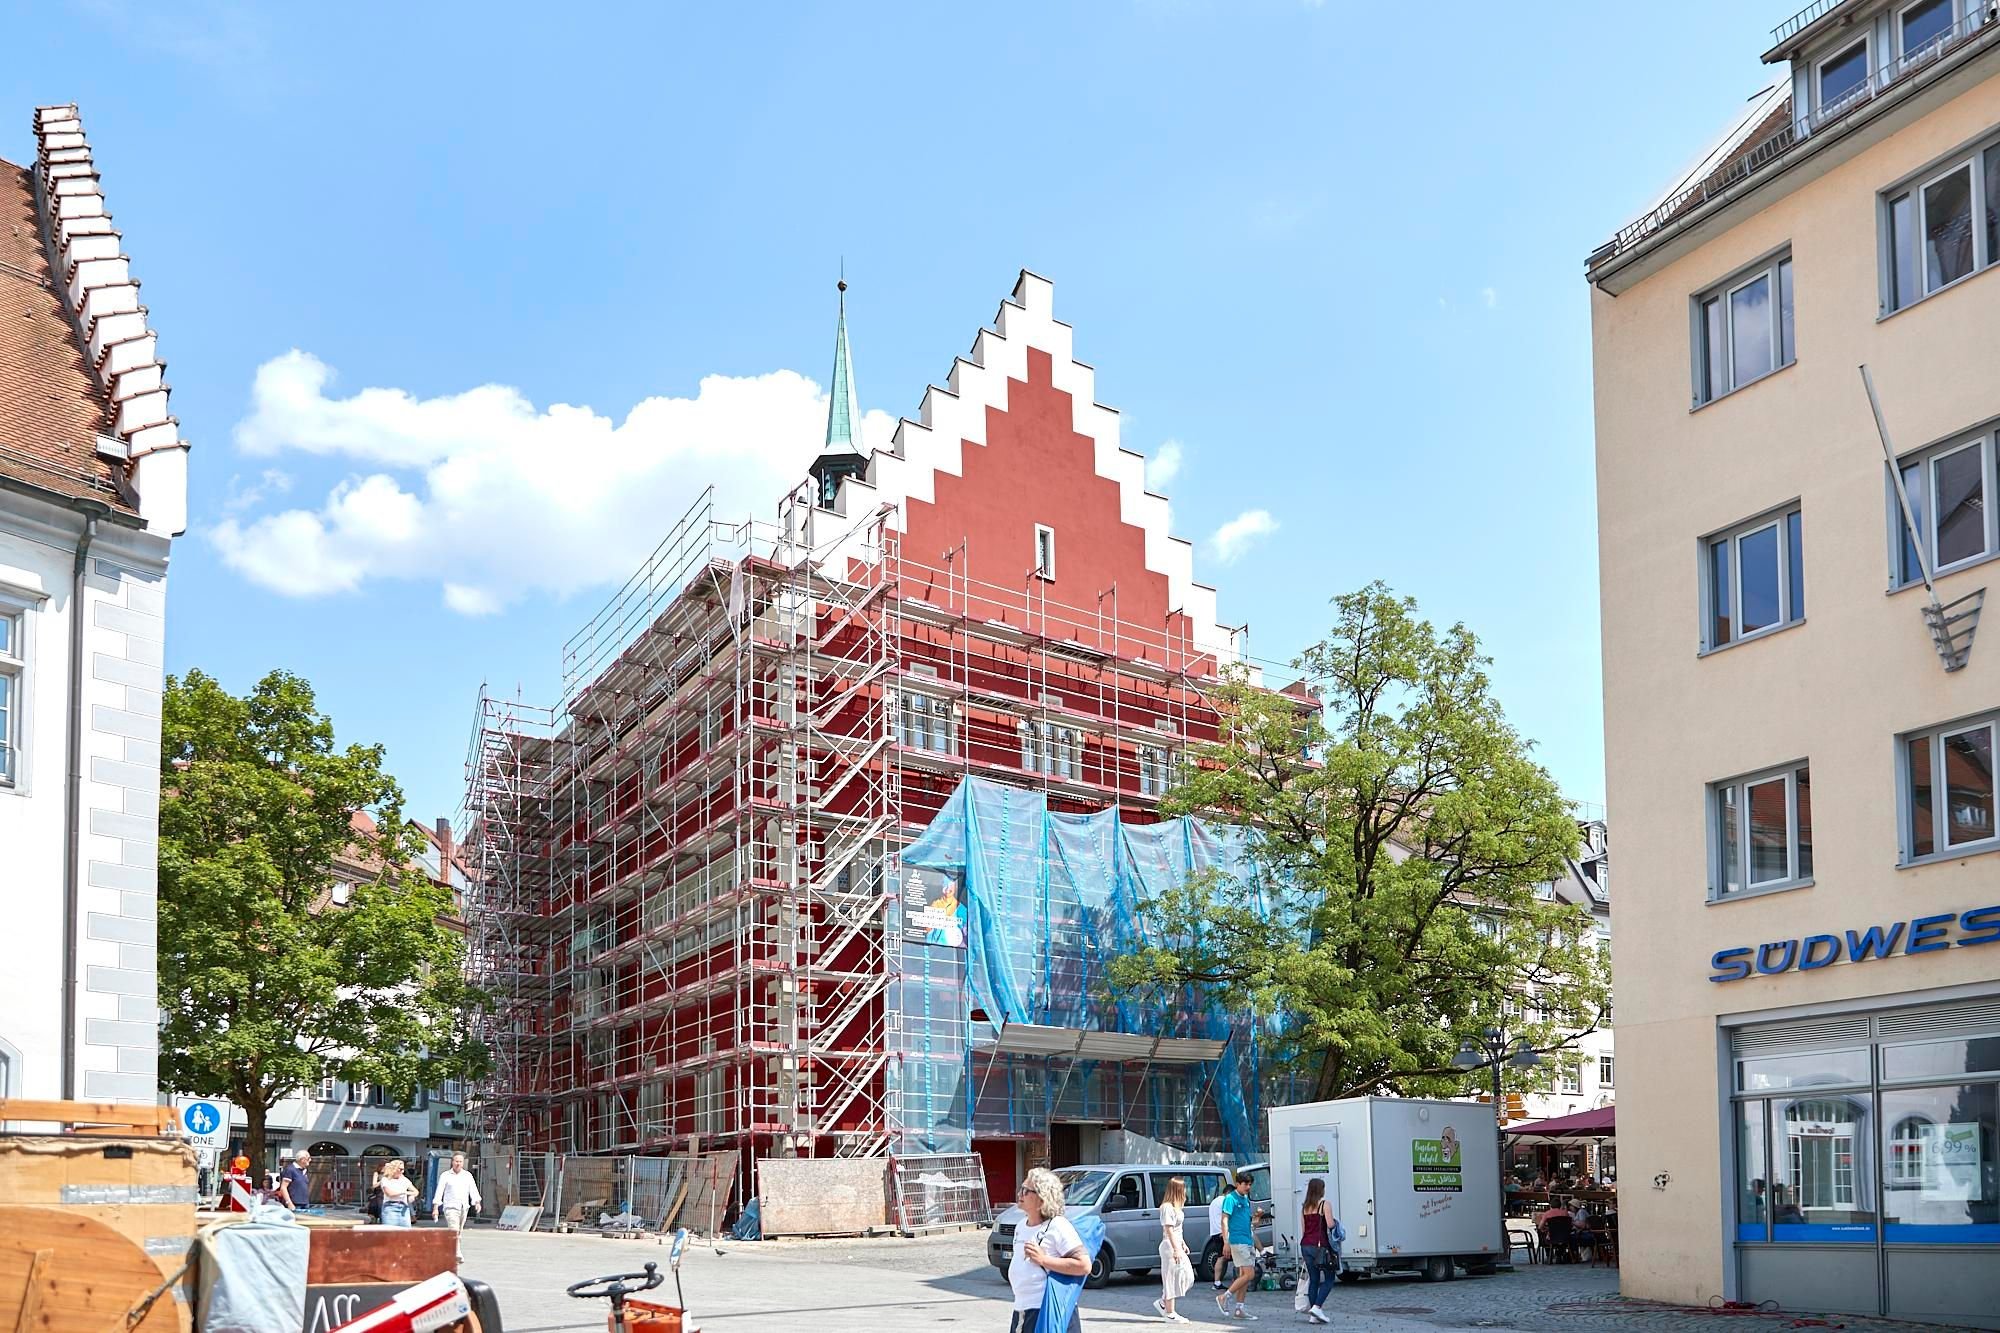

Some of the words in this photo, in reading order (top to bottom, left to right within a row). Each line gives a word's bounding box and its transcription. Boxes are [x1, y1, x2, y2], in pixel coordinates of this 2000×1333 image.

[1708, 905, 2000, 983] SÜDWES
[376, 1122, 400, 1132] MORE
[187, 1135, 215, 1146] ONE
